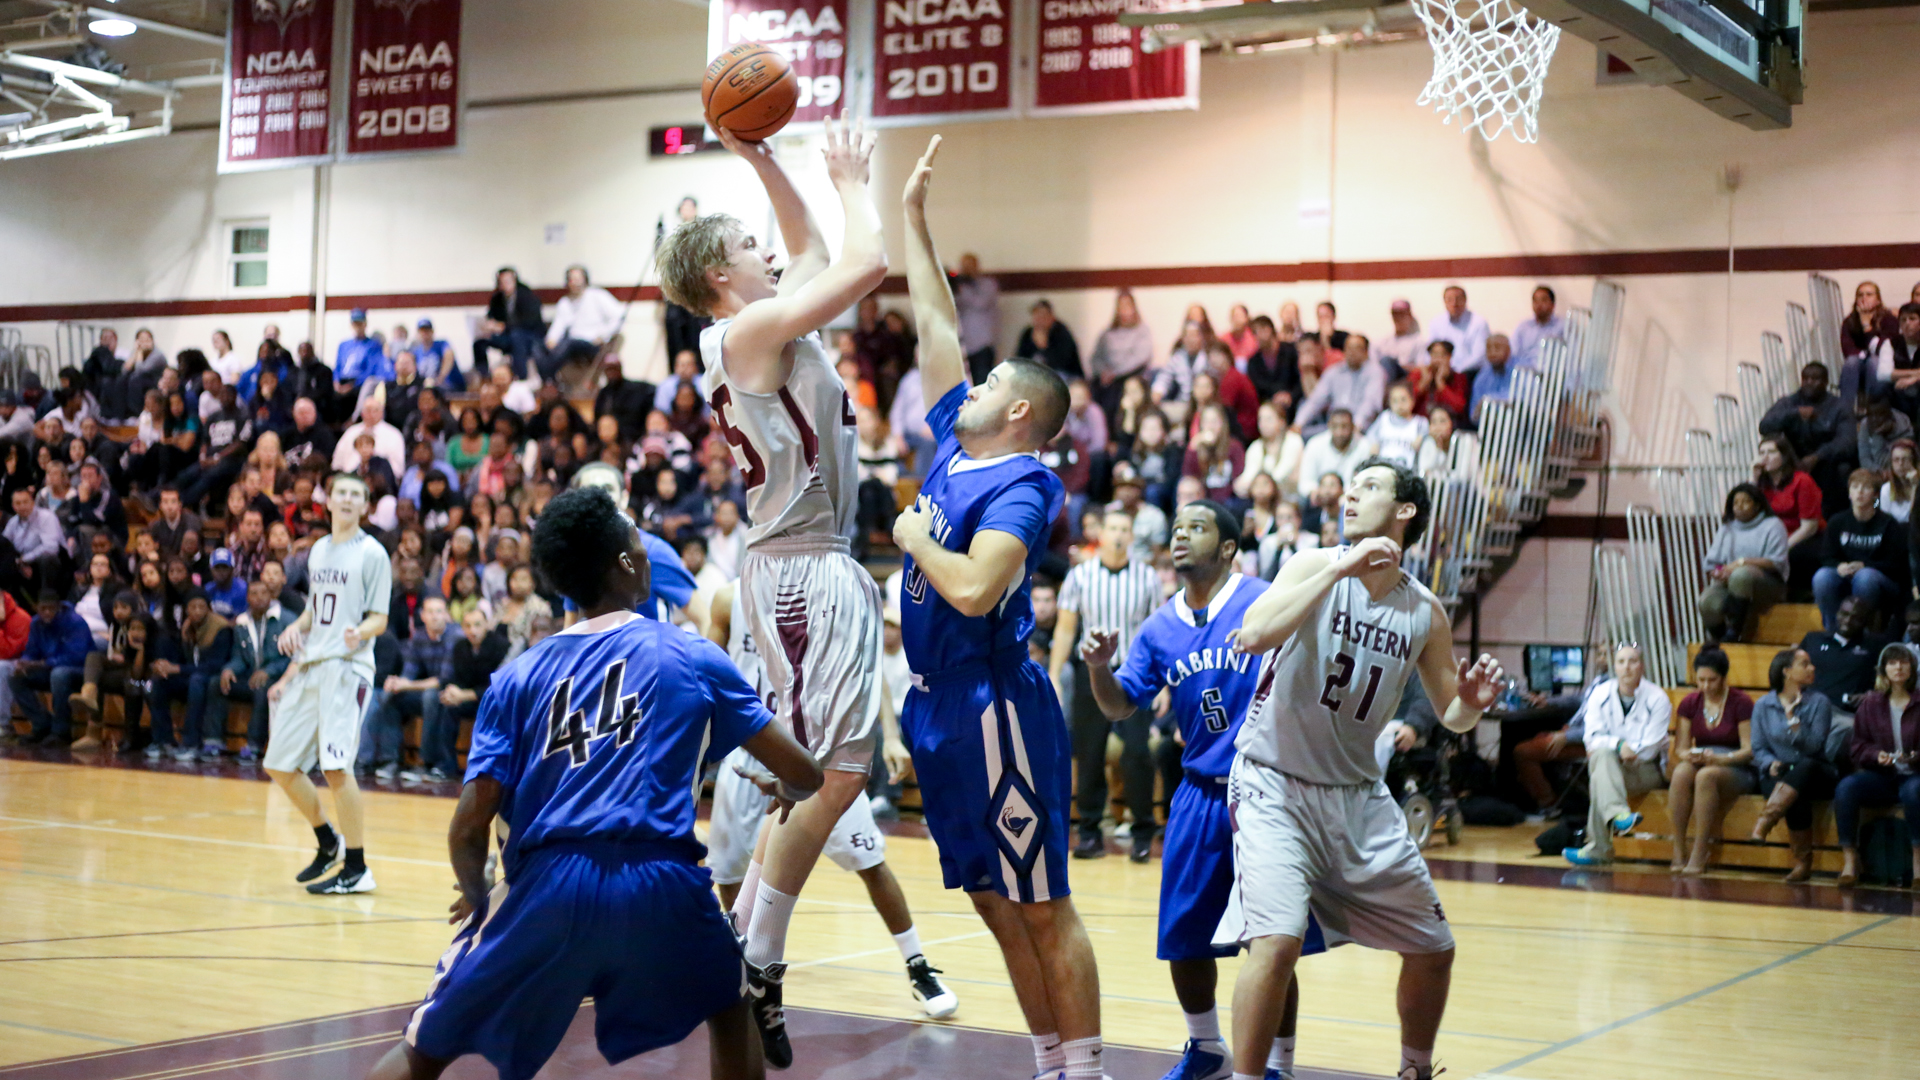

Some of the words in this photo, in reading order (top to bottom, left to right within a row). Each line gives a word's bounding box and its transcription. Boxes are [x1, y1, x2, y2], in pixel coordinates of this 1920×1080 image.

[728, 5, 843, 43] NCAA
[885, 0, 1003, 28] NCAA
[883, 26, 971, 55] ELITE
[980, 24, 1003, 47] 8
[246, 50, 315, 75] NCAA
[360, 41, 453, 74] NCAA
[706, 56, 728, 82] THE
[729, 59, 766, 88] C2C
[233, 72, 325, 94] TOURNAMENT
[357, 75, 424, 97] SWEET
[431, 71, 453, 91] 16
[796, 75, 842, 107] 09
[887, 61, 999, 100] 2010
[357, 105, 450, 139] 2008
[1332, 610, 1412, 661] EASTERN
[1166, 647, 1252, 687] CABRINI
[1318, 651, 1385, 722] 21
[542, 658, 643, 769] 44
[1200, 686, 1230, 734] 5
[850, 832, 875, 851] EU
